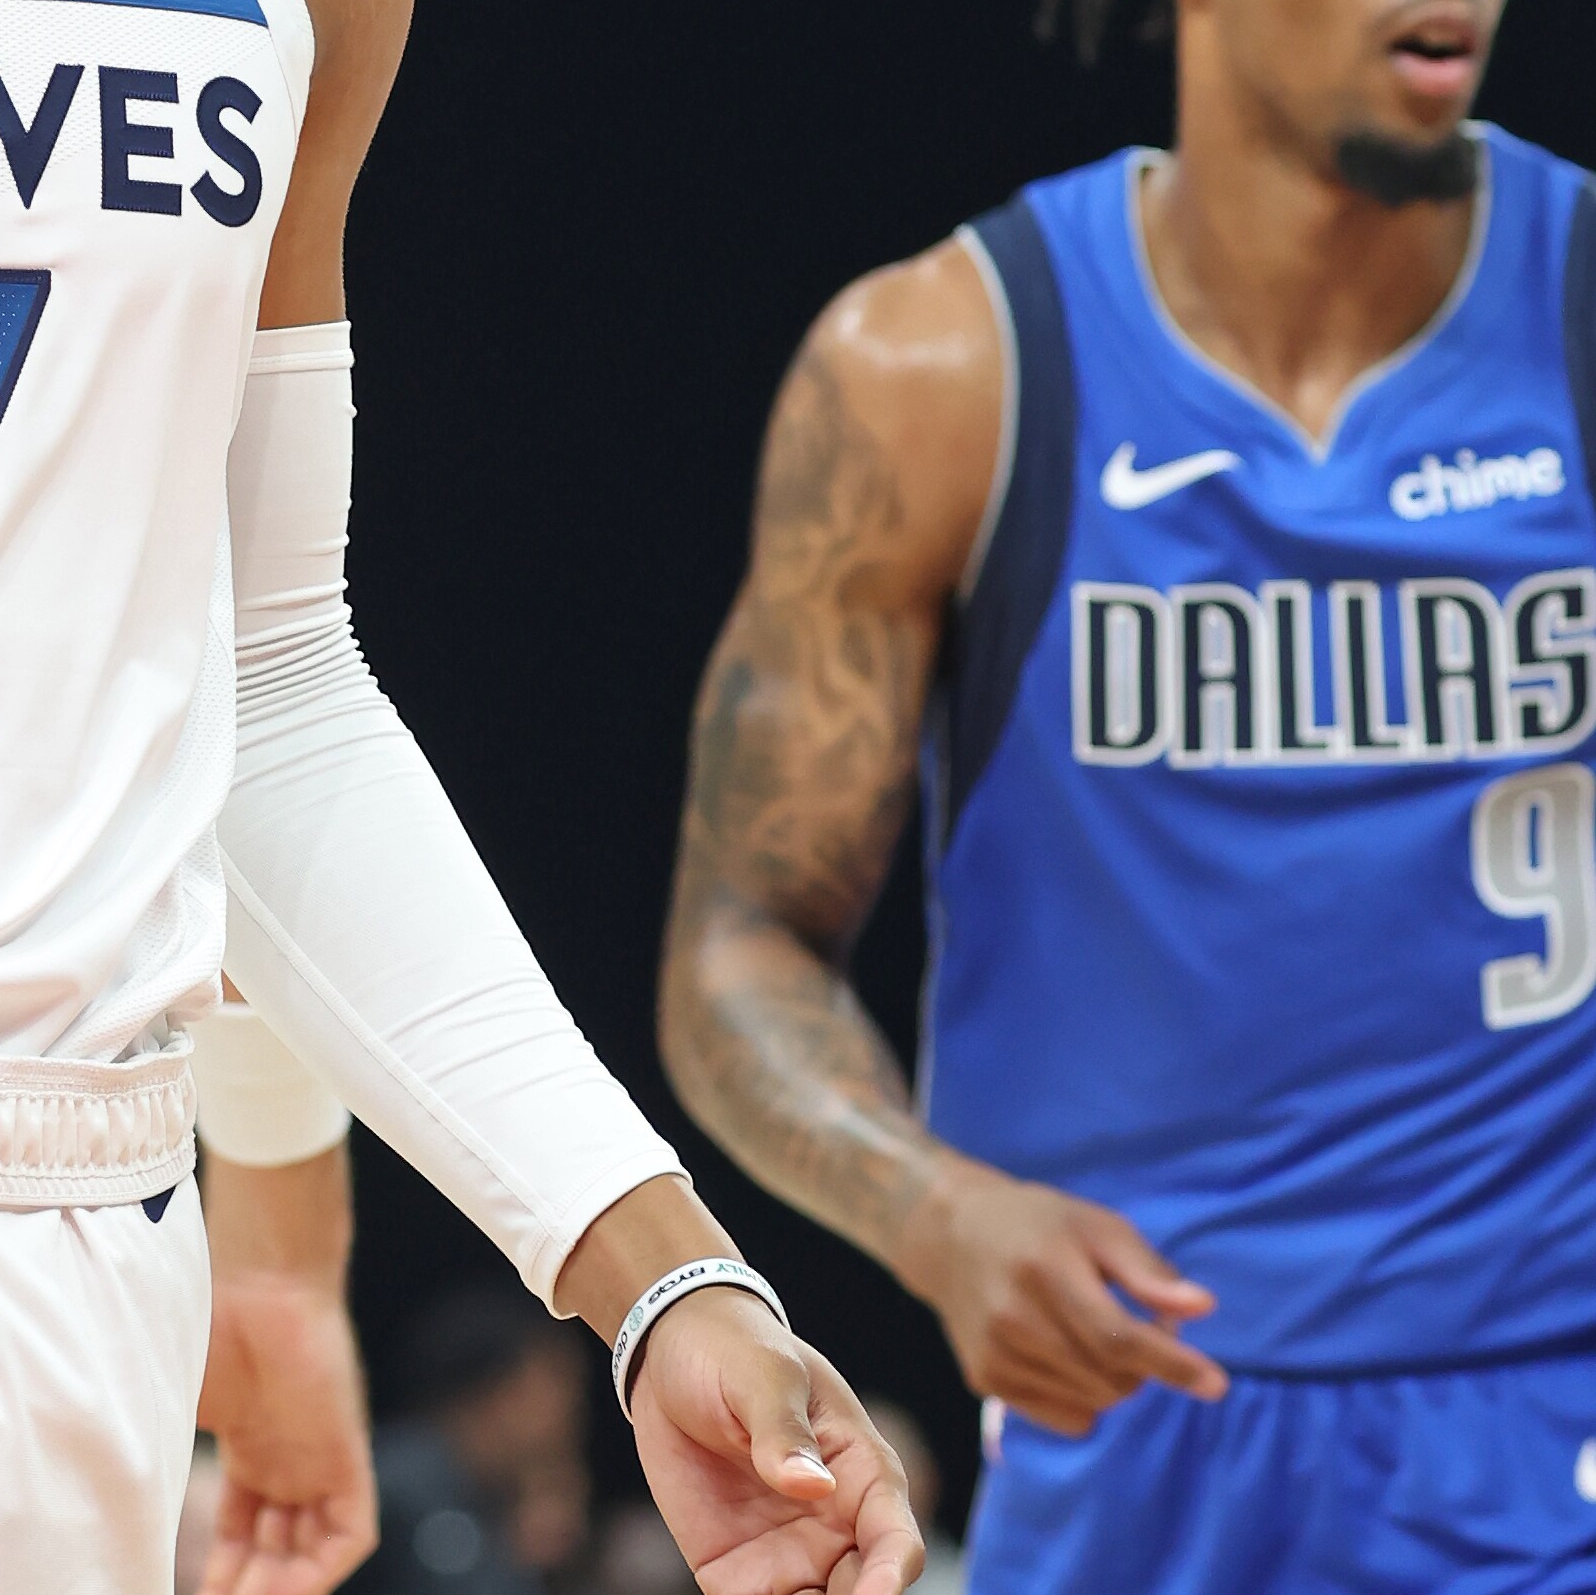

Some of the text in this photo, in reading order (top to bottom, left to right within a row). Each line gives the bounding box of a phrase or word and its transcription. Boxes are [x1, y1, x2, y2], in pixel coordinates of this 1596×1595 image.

[1390, 447, 1567, 522] chime
[1070, 567, 1596, 770] DALLAS
[1471, 761, 1596, 1031] 9
